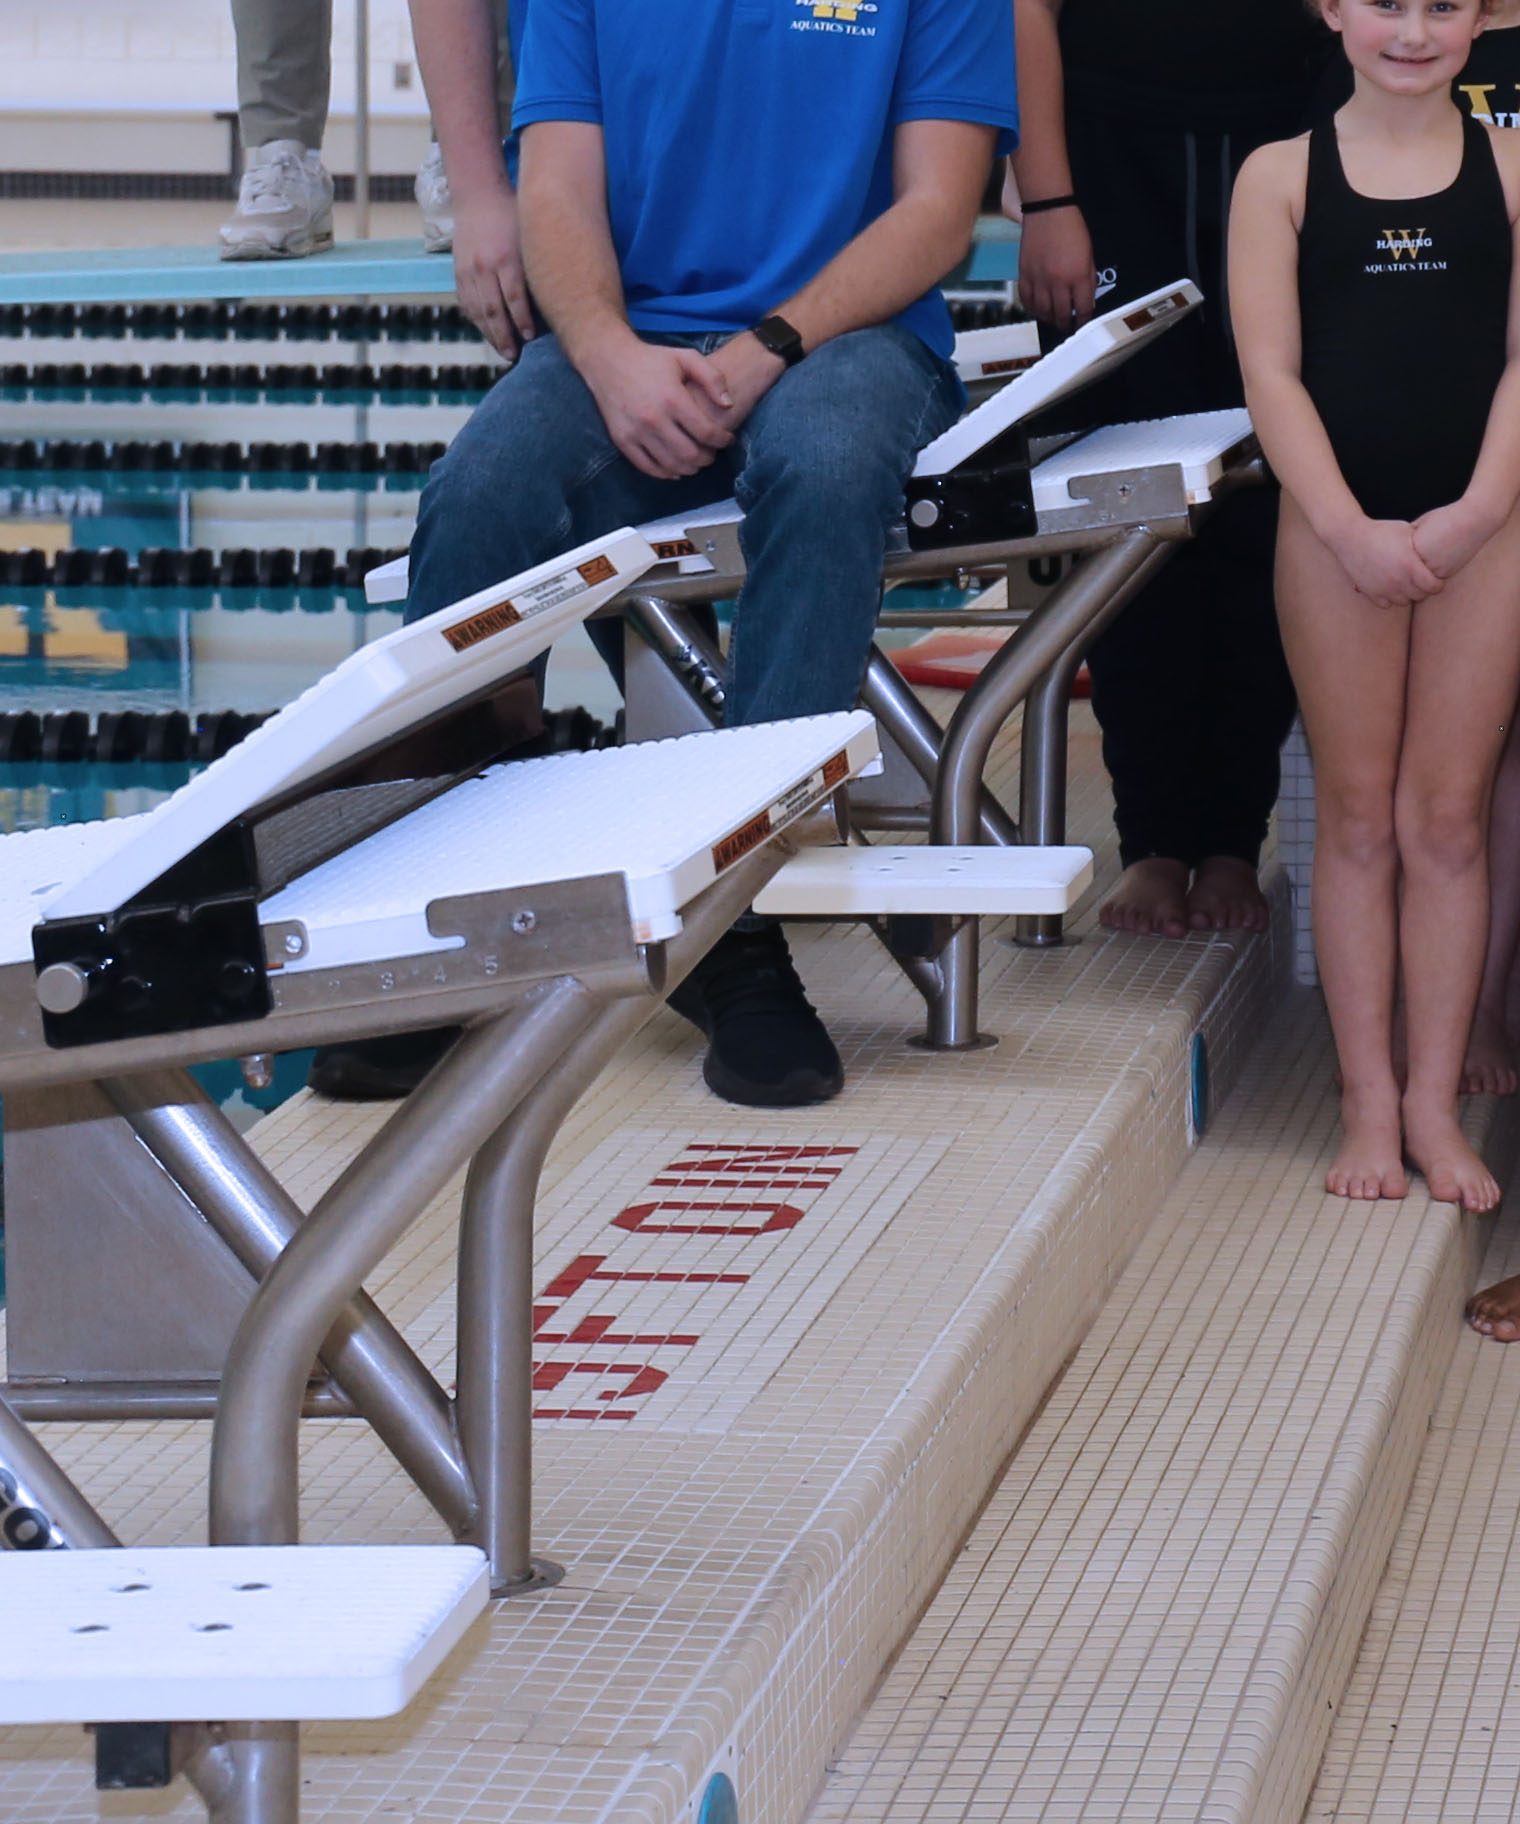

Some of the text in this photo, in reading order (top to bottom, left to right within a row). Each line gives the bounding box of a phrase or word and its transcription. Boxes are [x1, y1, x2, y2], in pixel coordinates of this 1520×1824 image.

[790, 19, 876, 37] AQUATICS TEAM
[1376, 237, 1433, 250] HARDING
[1363, 261, 1447, 275] AQUATICS TEAM
[454, 604, 520, 640] WARNING
[719, 811, 771, 864] WARNING
[484, 955, 498, 975] 5
